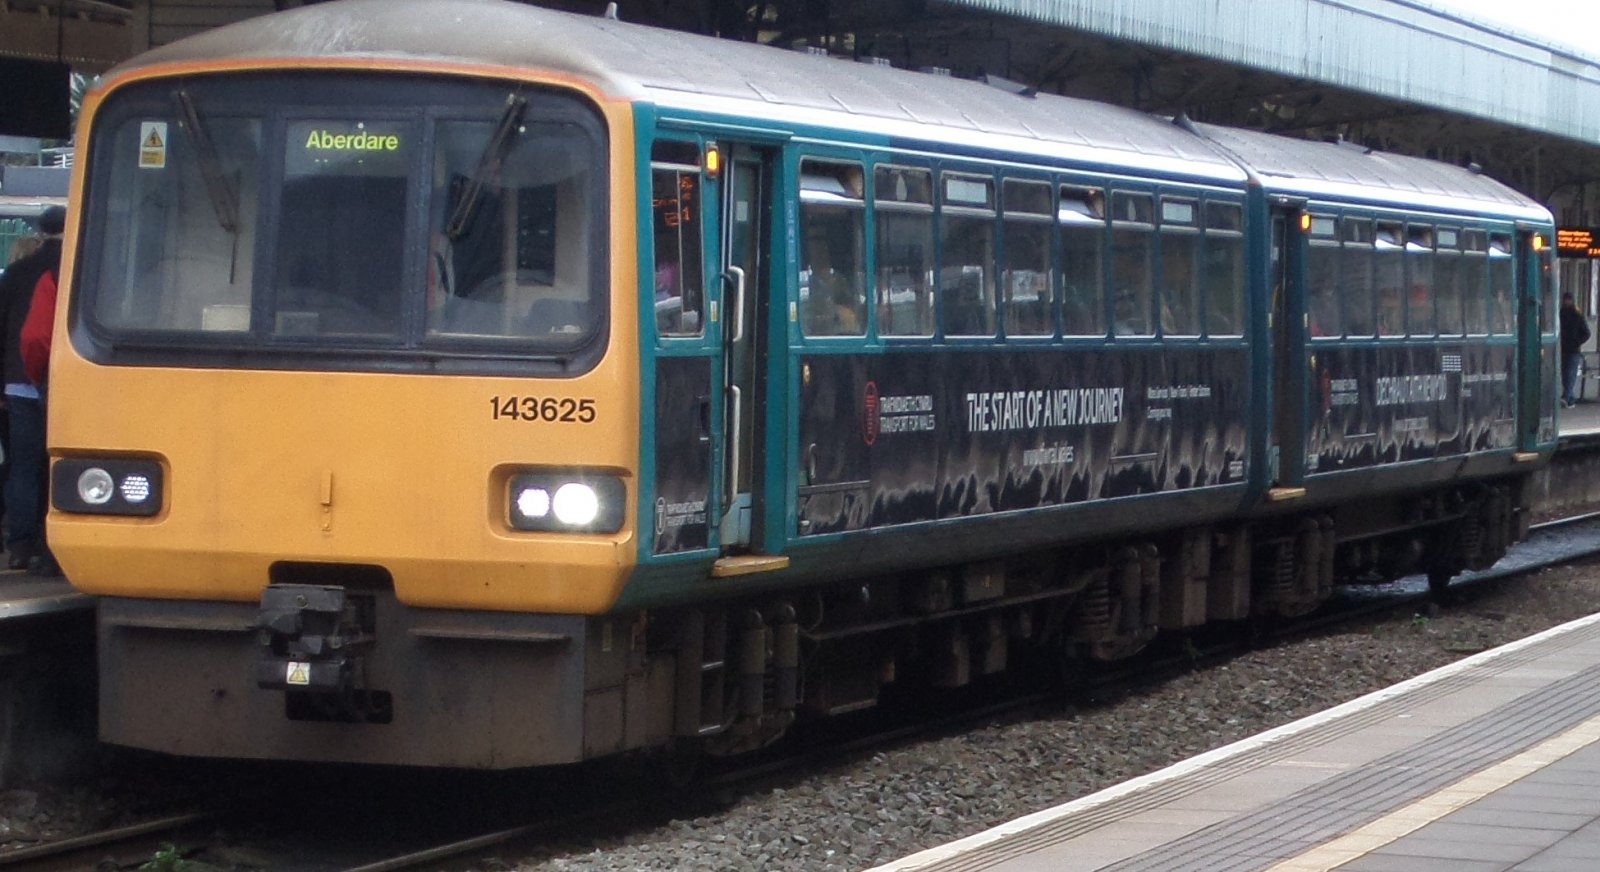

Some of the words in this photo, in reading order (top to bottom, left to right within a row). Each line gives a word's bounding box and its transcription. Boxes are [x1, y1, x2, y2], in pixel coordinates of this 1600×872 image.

[305, 130, 399, 151] Aberdare
[490, 396, 596, 422] 143625
[967, 392, 989, 432] THE
[991, 391, 1025, 431] START
[1026, 390, 1043, 428] OF
[1043, 389, 1053, 428] A
[1053, 388, 1078, 426] NEW
[1078, 387, 1124, 425] JOURNEY
